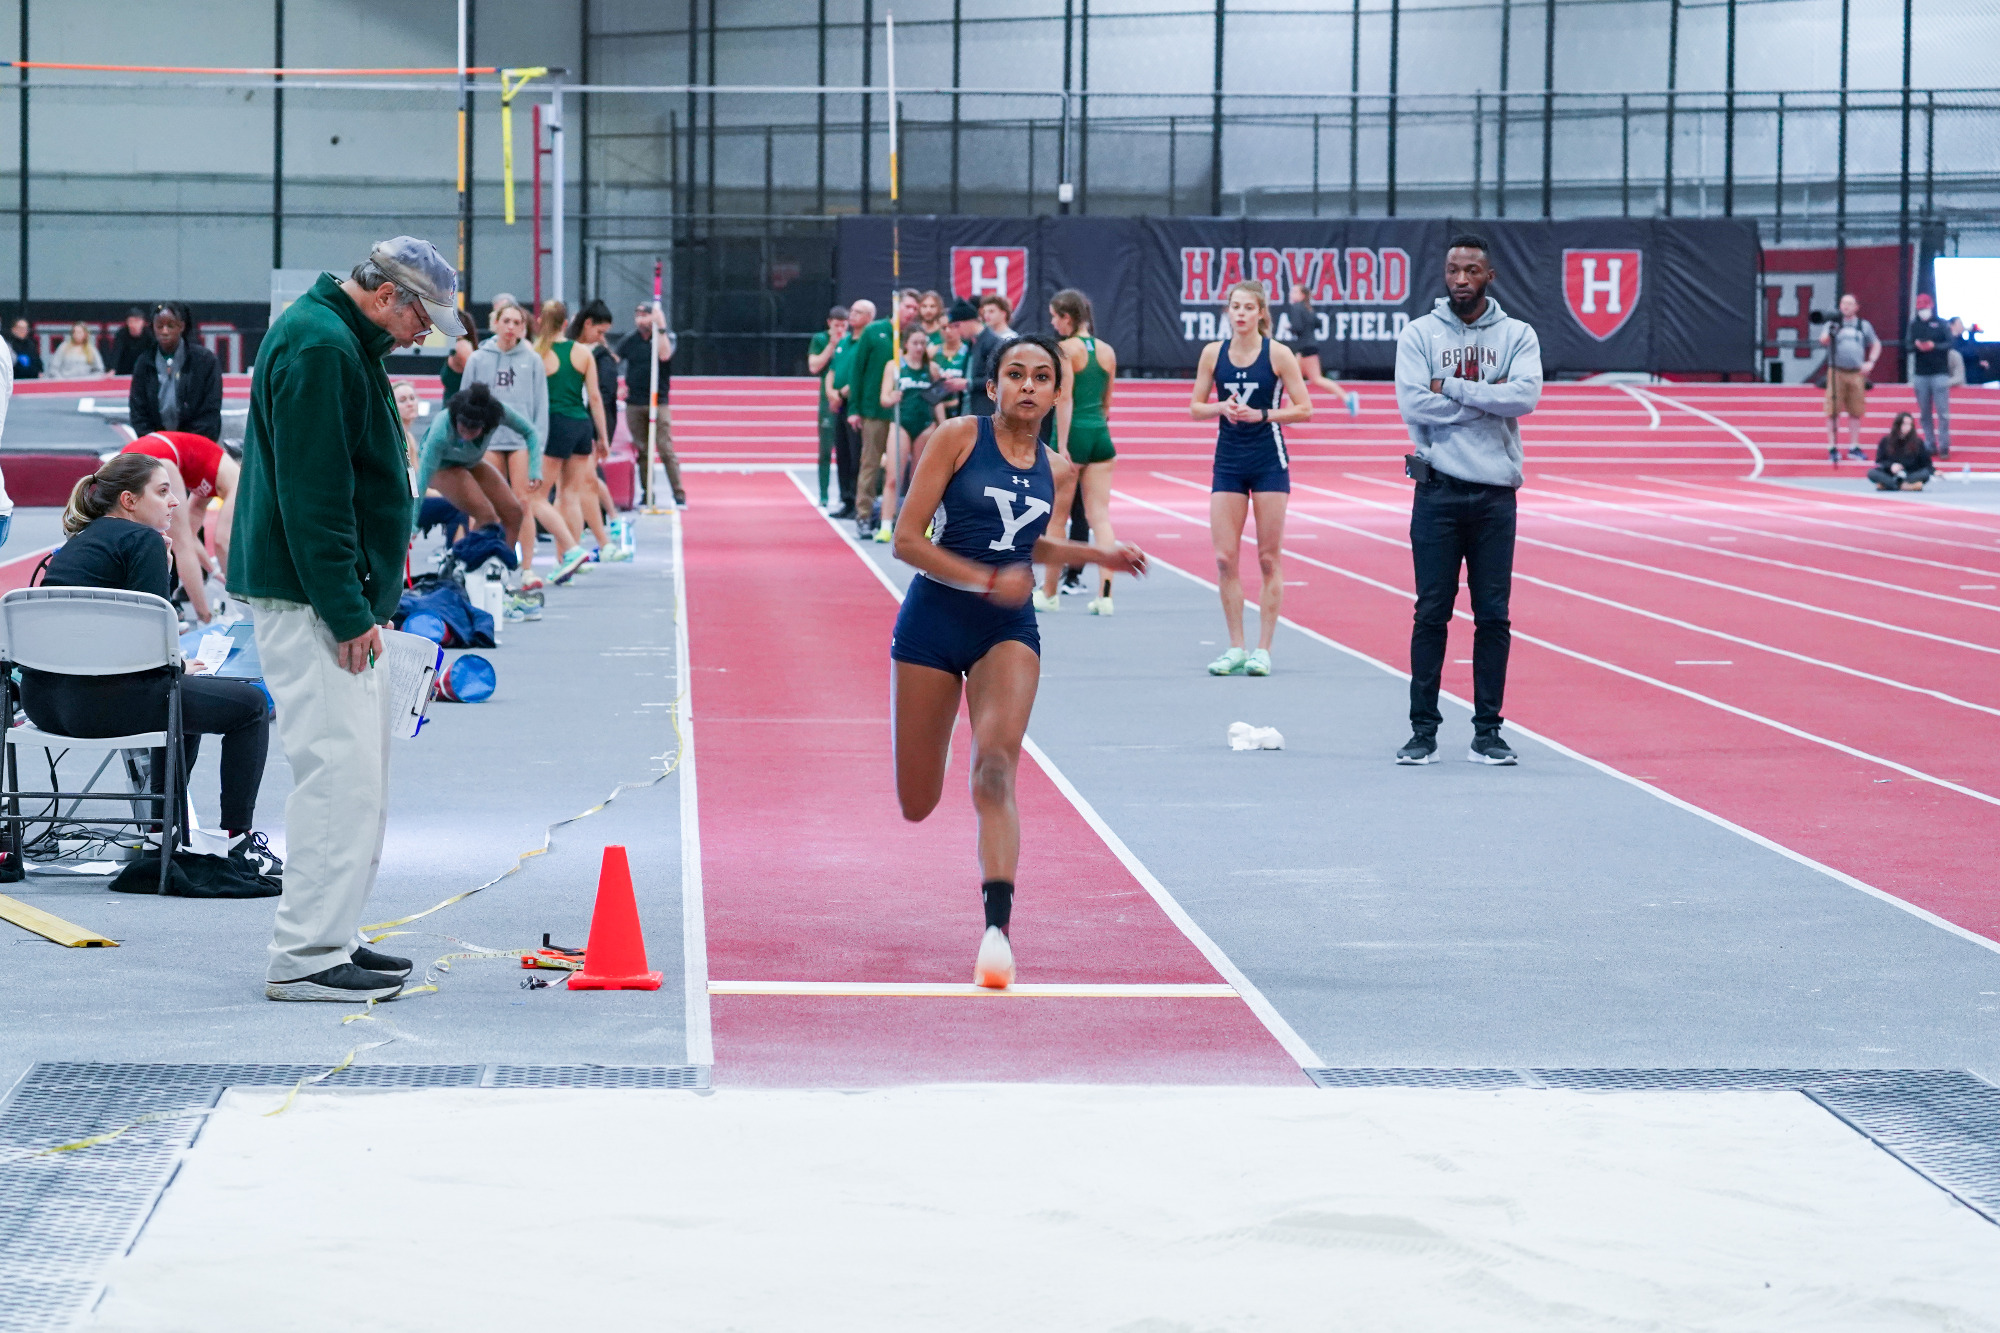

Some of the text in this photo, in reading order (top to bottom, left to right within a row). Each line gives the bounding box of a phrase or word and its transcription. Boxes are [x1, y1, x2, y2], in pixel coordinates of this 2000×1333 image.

[970, 256, 1009, 296] H
[1181, 247, 1410, 305] HARVARD
[1581, 258, 1622, 314] H
[1335, 312, 1410, 341] FIELD
[1764, 285, 1813, 358] H
[984, 486, 1050, 551] Y
